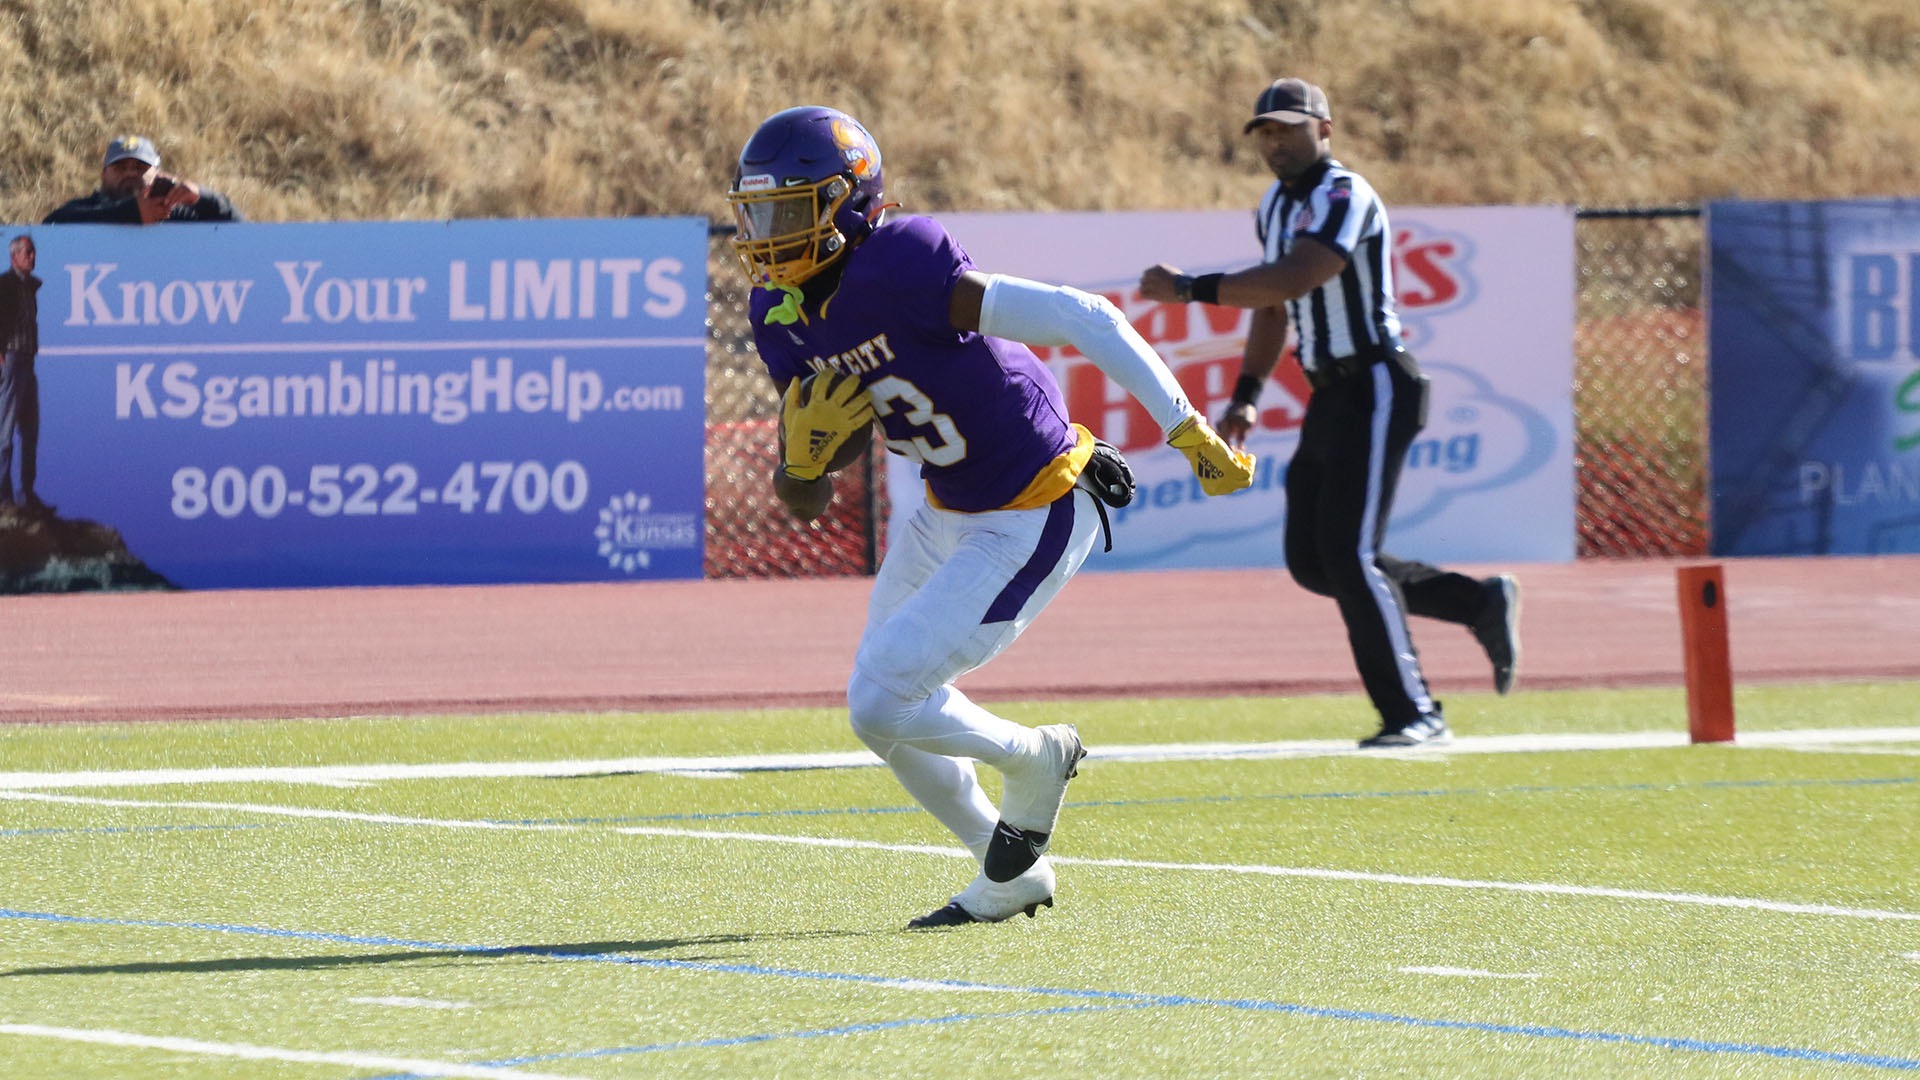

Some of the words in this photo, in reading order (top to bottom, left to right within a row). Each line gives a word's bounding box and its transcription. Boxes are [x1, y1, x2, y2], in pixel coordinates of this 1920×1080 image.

[64, 263, 253, 326] Know
[274, 261, 427, 323] Your
[449, 257, 687, 321] LIMITS
[841, 332, 896, 376] CITY
[115, 356, 684, 428] KSgamblingHelp.com
[811, 431, 838, 462] adidas
[1197, 451, 1224, 478] adidas
[171, 460, 589, 519] 800-522-4700
[615, 514, 697, 543] Kansas
